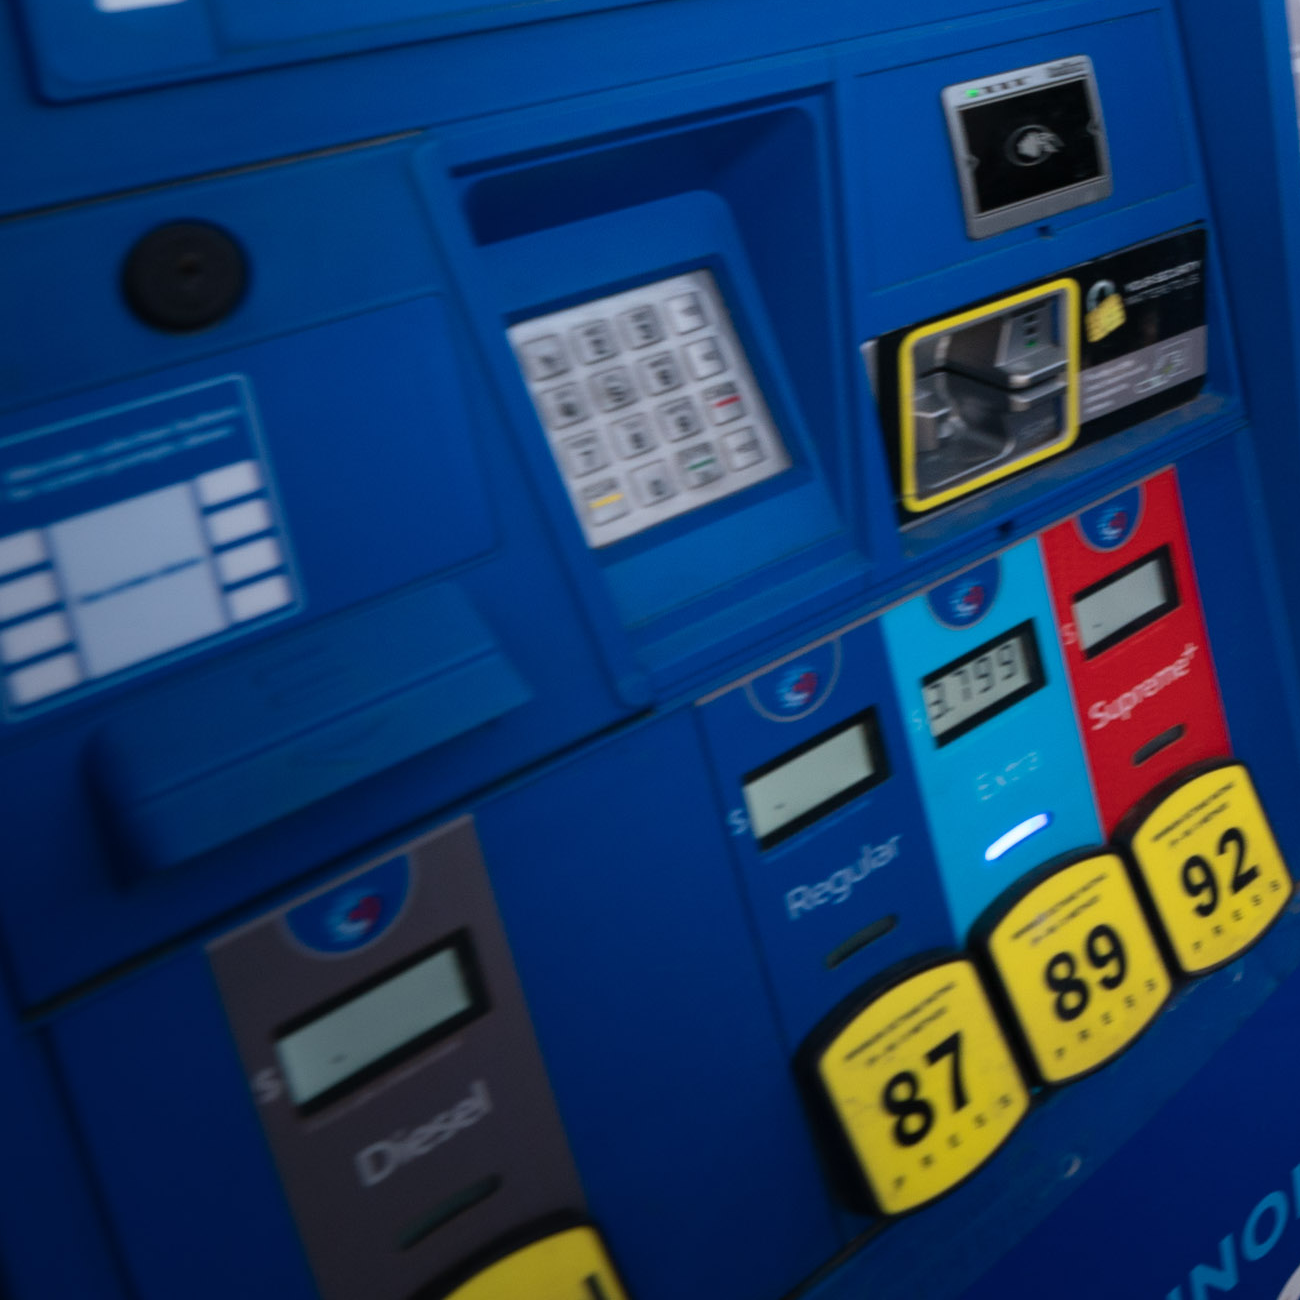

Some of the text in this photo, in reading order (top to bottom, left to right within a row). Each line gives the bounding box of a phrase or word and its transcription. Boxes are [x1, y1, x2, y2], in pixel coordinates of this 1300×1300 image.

[785, 833, 901, 921] Regular
[1181, 826, 1261, 919] 92
[1044, 923, 1127, 1023] 89
[354, 1079, 493, 1187] Diesel
[882, 1030, 969, 1149] 87
